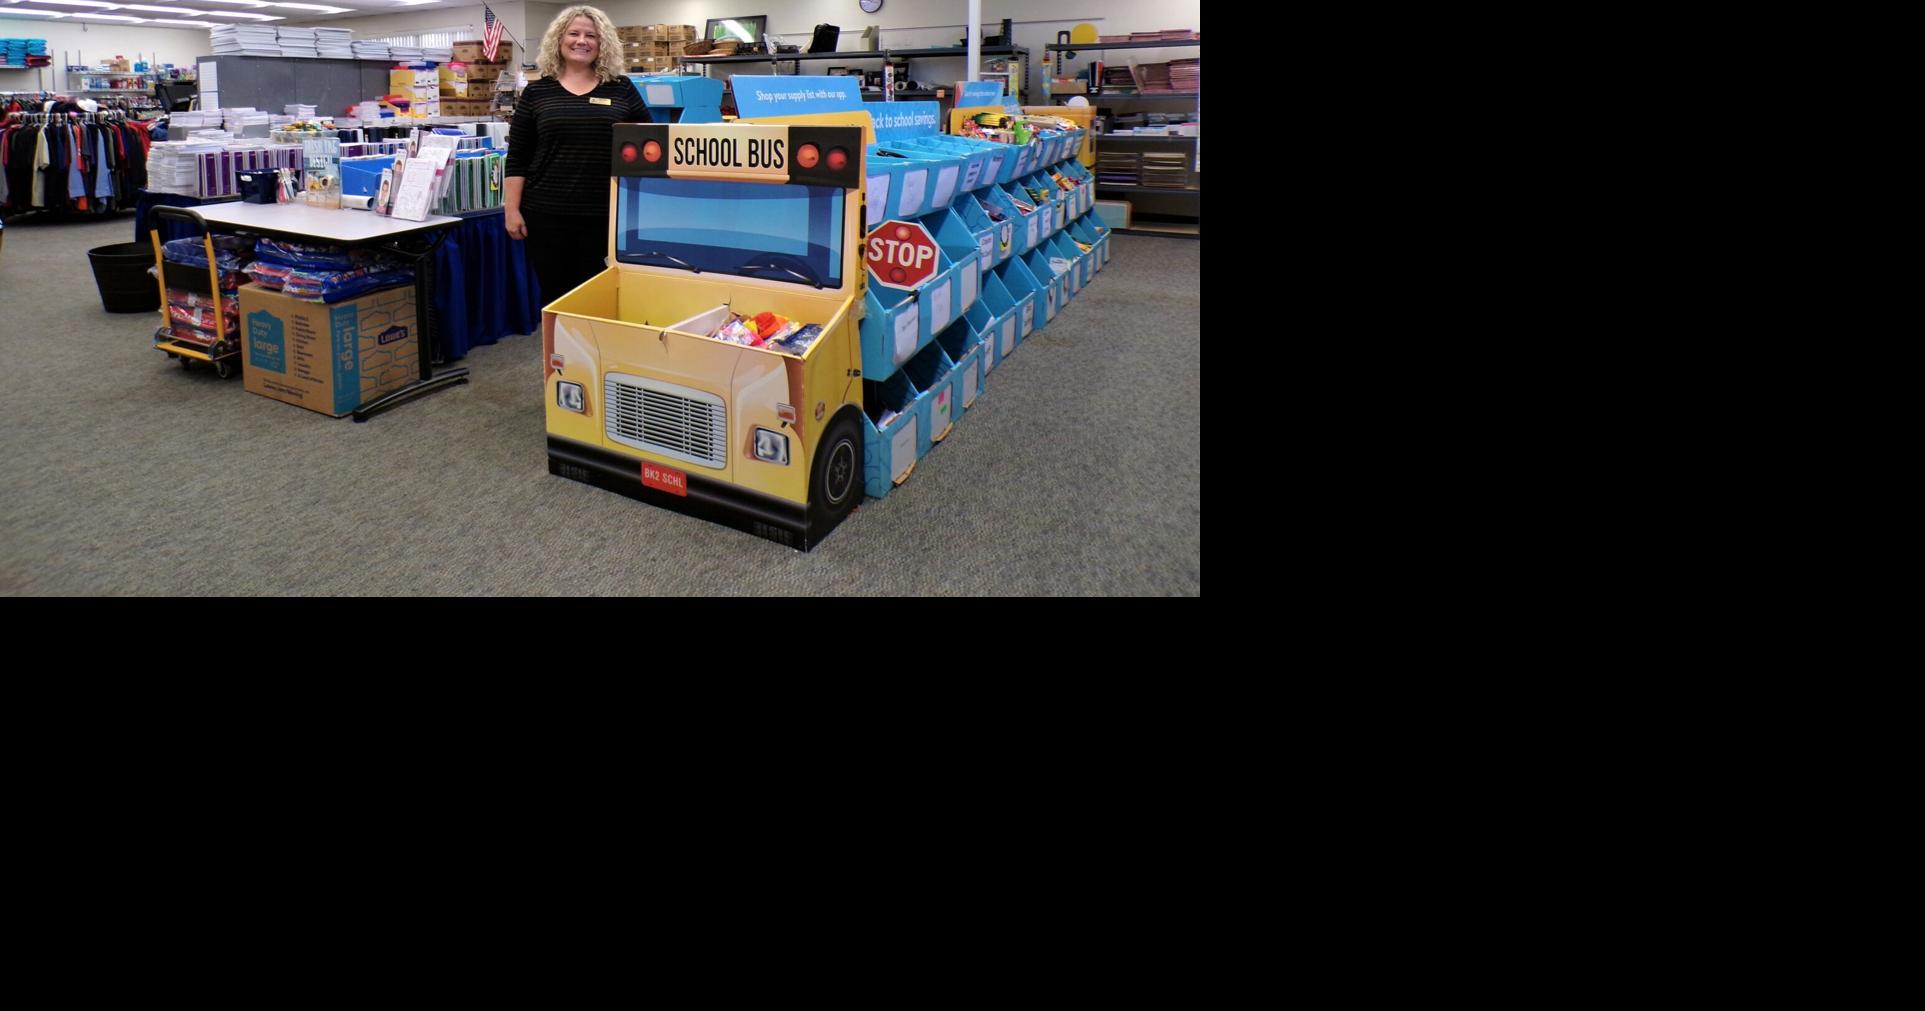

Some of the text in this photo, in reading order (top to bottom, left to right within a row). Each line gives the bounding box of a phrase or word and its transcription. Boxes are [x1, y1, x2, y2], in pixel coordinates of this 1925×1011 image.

[755, 90, 773, 103] Shop
[773, 92, 787, 103] your
[787, 90, 806, 103] supply
[806, 89, 816, 99] list
[816, 89, 828, 99] with
[885, 112, 893, 127] to
[894, 111, 914, 127] school
[674, 137, 784, 169] SCHOOL BUS
[868, 237, 934, 269] STOP
[253, 337, 280, 355] large
[644, 467, 684, 488] BK2 SCHL
